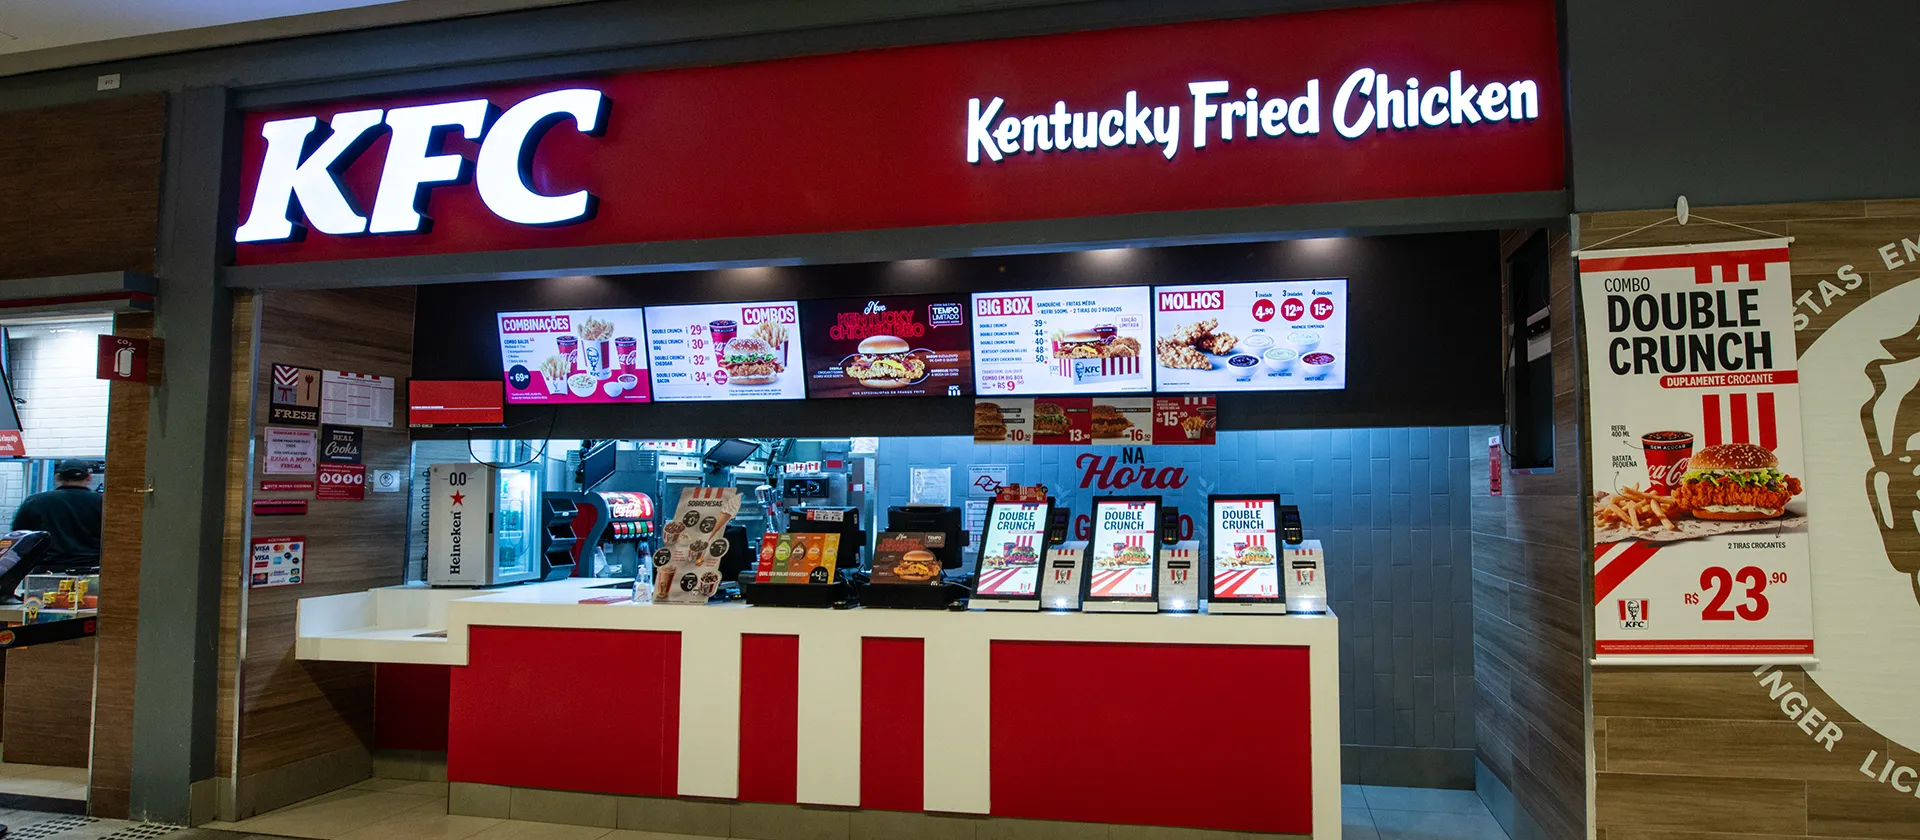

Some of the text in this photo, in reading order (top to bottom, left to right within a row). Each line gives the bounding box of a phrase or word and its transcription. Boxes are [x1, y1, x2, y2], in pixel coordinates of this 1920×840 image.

[967, 67, 1538, 163] Kentucky Fried Chicken
[235, 88, 602, 243] KFC
[1604, 277, 1650, 293] COMBO
[1161, 292, 1221, 310] MOLHOS
[1793, 264, 1863, 332] STAS
[932, 306, 959, 314] TEMPO
[978, 298, 1031, 315] BIG BOX
[1607, 288, 1761, 333] DOUBLE
[744, 307, 795, 324] COMBOS
[838, 311, 914, 326] KENTUCKY
[504, 316, 569, 333] COMBINAÇÕES
[830, 324, 892, 340] CHICKEN
[1609, 330, 1773, 375] CRUNCH
[1667, 373, 1774, 387] DUPLAMENTE CROCANTE
[274, 408, 317, 420] FRESH
[325, 442, 359, 456] Cooks
[1122, 448, 1145, 464] NA
[450, 472, 466, 486] 0.0
[1076, 453, 1189, 490] Hora
[998, 512, 1035, 520] DOUBLE
[1104, 511, 1142, 520] DOUBLE
[1222, 510, 1261, 519] DOUBLE
[997, 522, 1035, 530] CRUNCH
[1104, 521, 1144, 530] CRUNCH
[1222, 520, 1264, 530] CRUNCH
[450, 511, 462, 575] Heineken
[1684, 593, 1699, 605] R$
[1752, 664, 1920, 800] INGER LIC
